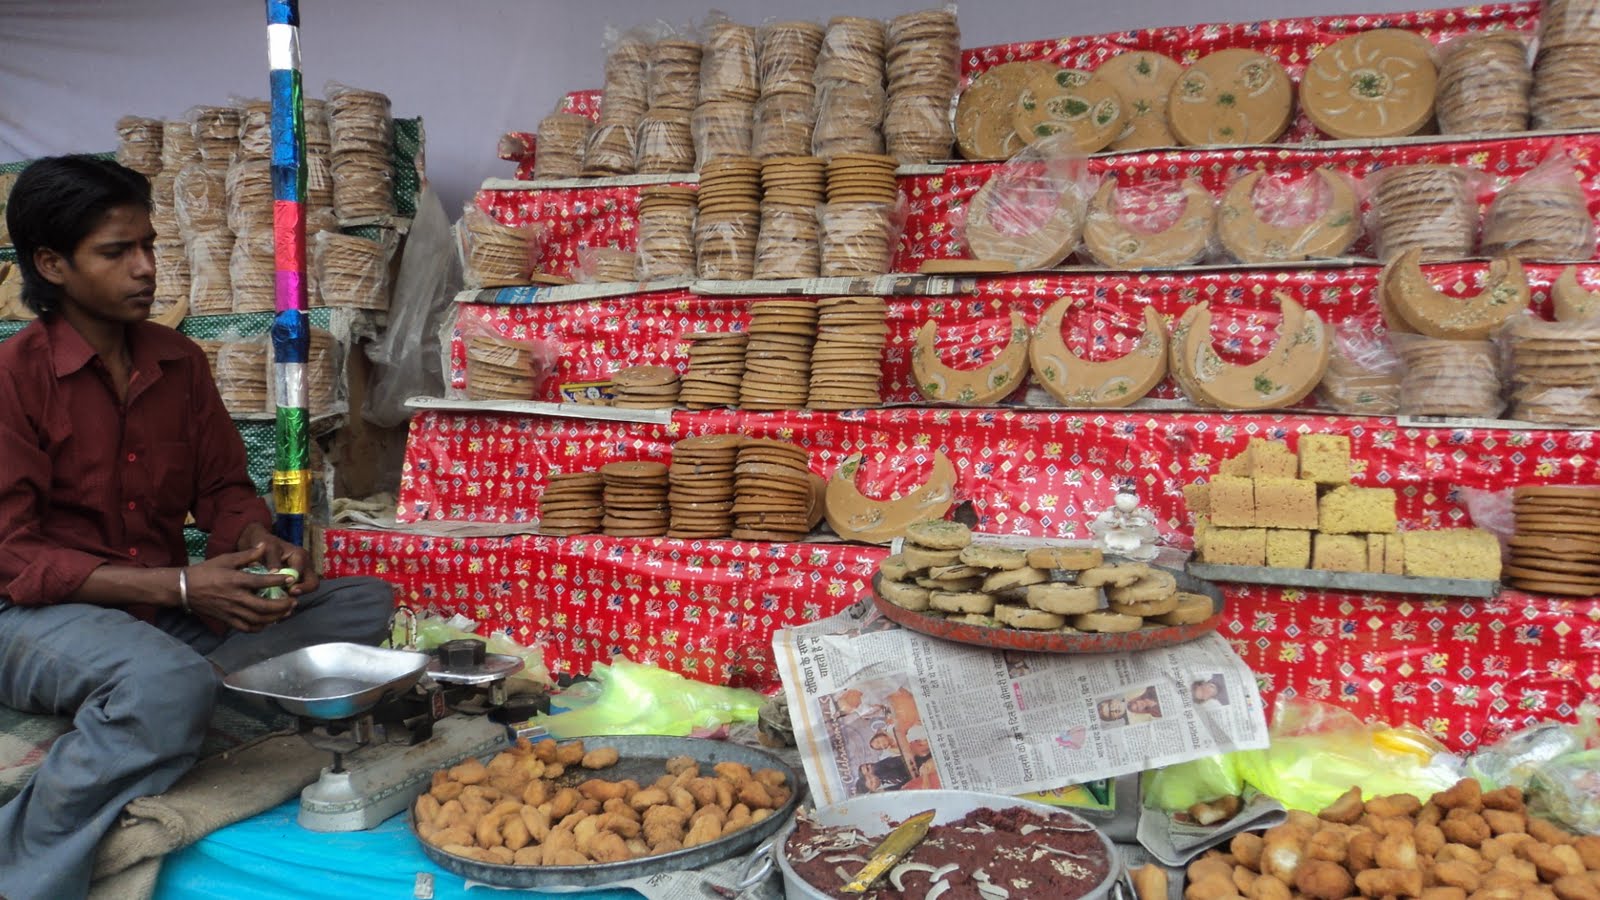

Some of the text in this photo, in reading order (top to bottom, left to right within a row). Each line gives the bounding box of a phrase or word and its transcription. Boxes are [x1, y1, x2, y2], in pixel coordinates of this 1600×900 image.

[798, 655, 810, 666] के
[813, 653, 829, 678] चाहती
[801, 666, 818, 695] दीपिका
[1005, 710, 1018, 725] दिल
[826, 722, 854, 785] Celebrations
